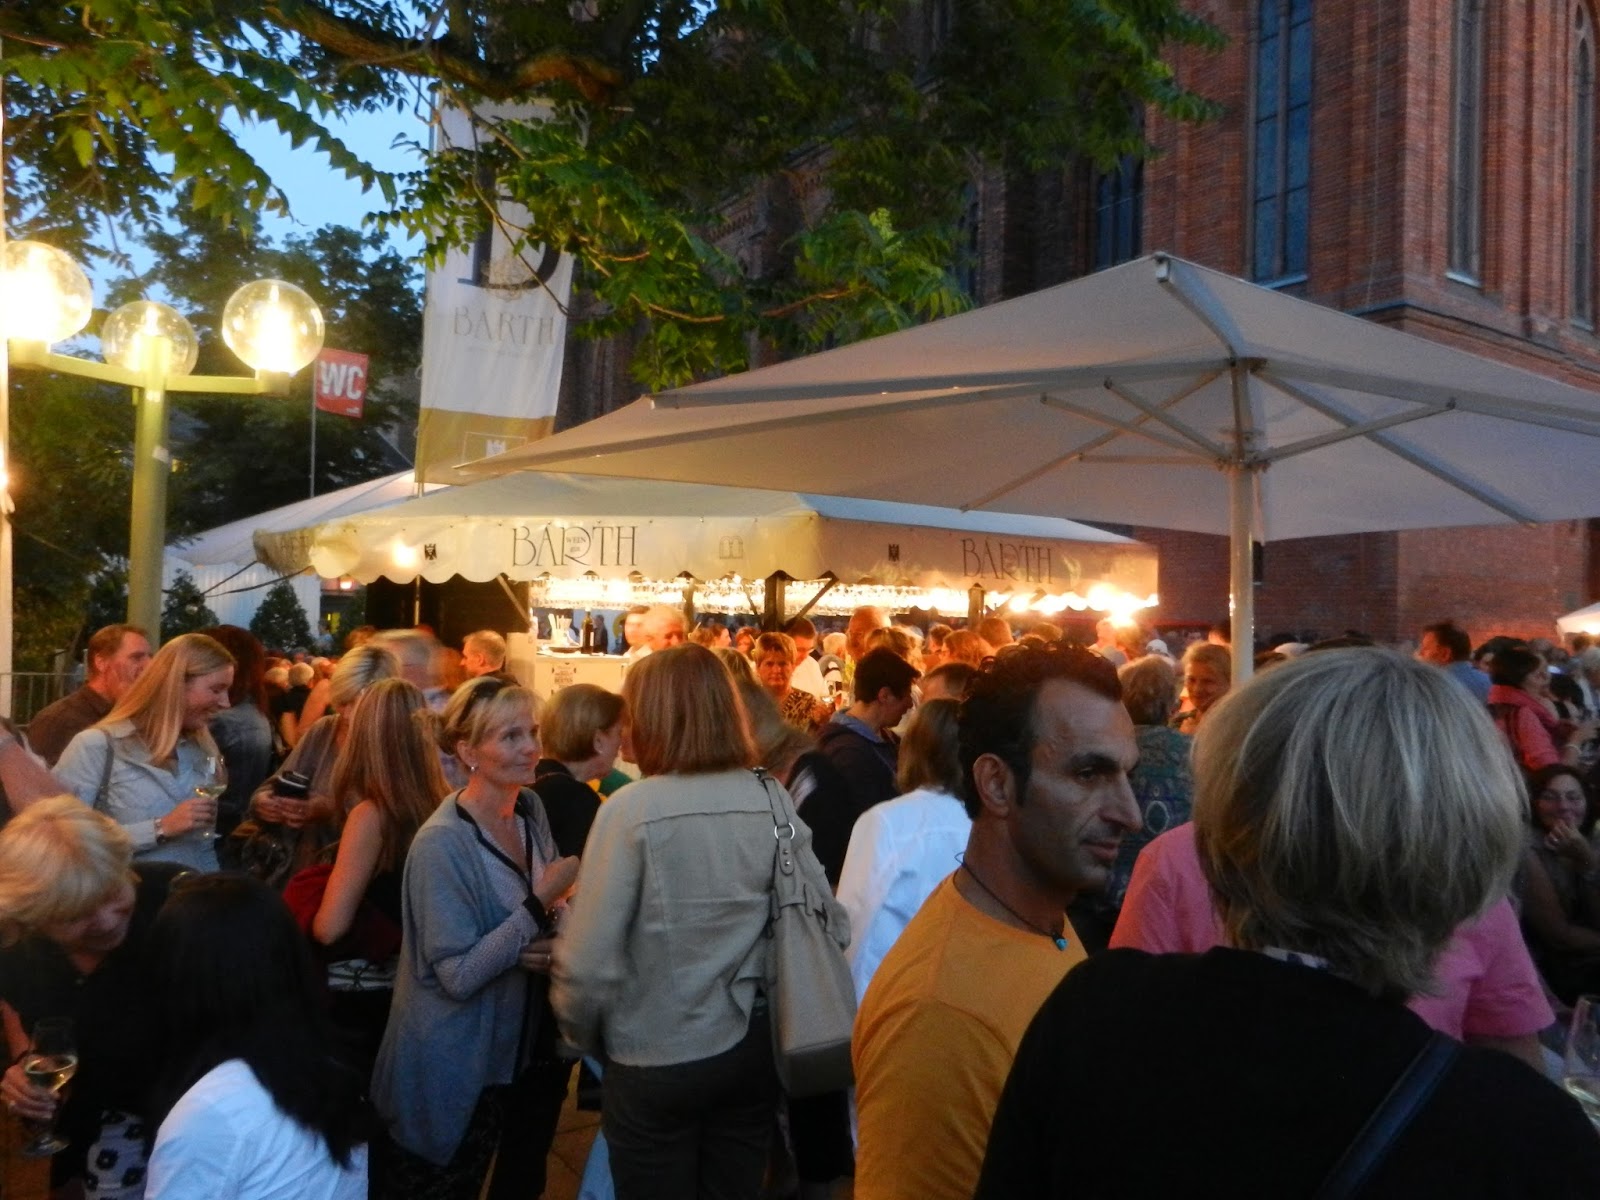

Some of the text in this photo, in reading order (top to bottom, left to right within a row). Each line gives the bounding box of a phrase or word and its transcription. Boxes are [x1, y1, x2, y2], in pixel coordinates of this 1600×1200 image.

[454, 305, 555, 345] BARTH
[320, 360, 364, 400] WC
[512, 525, 639, 567] BARTH
[961, 537, 1053, 584] BARTH
